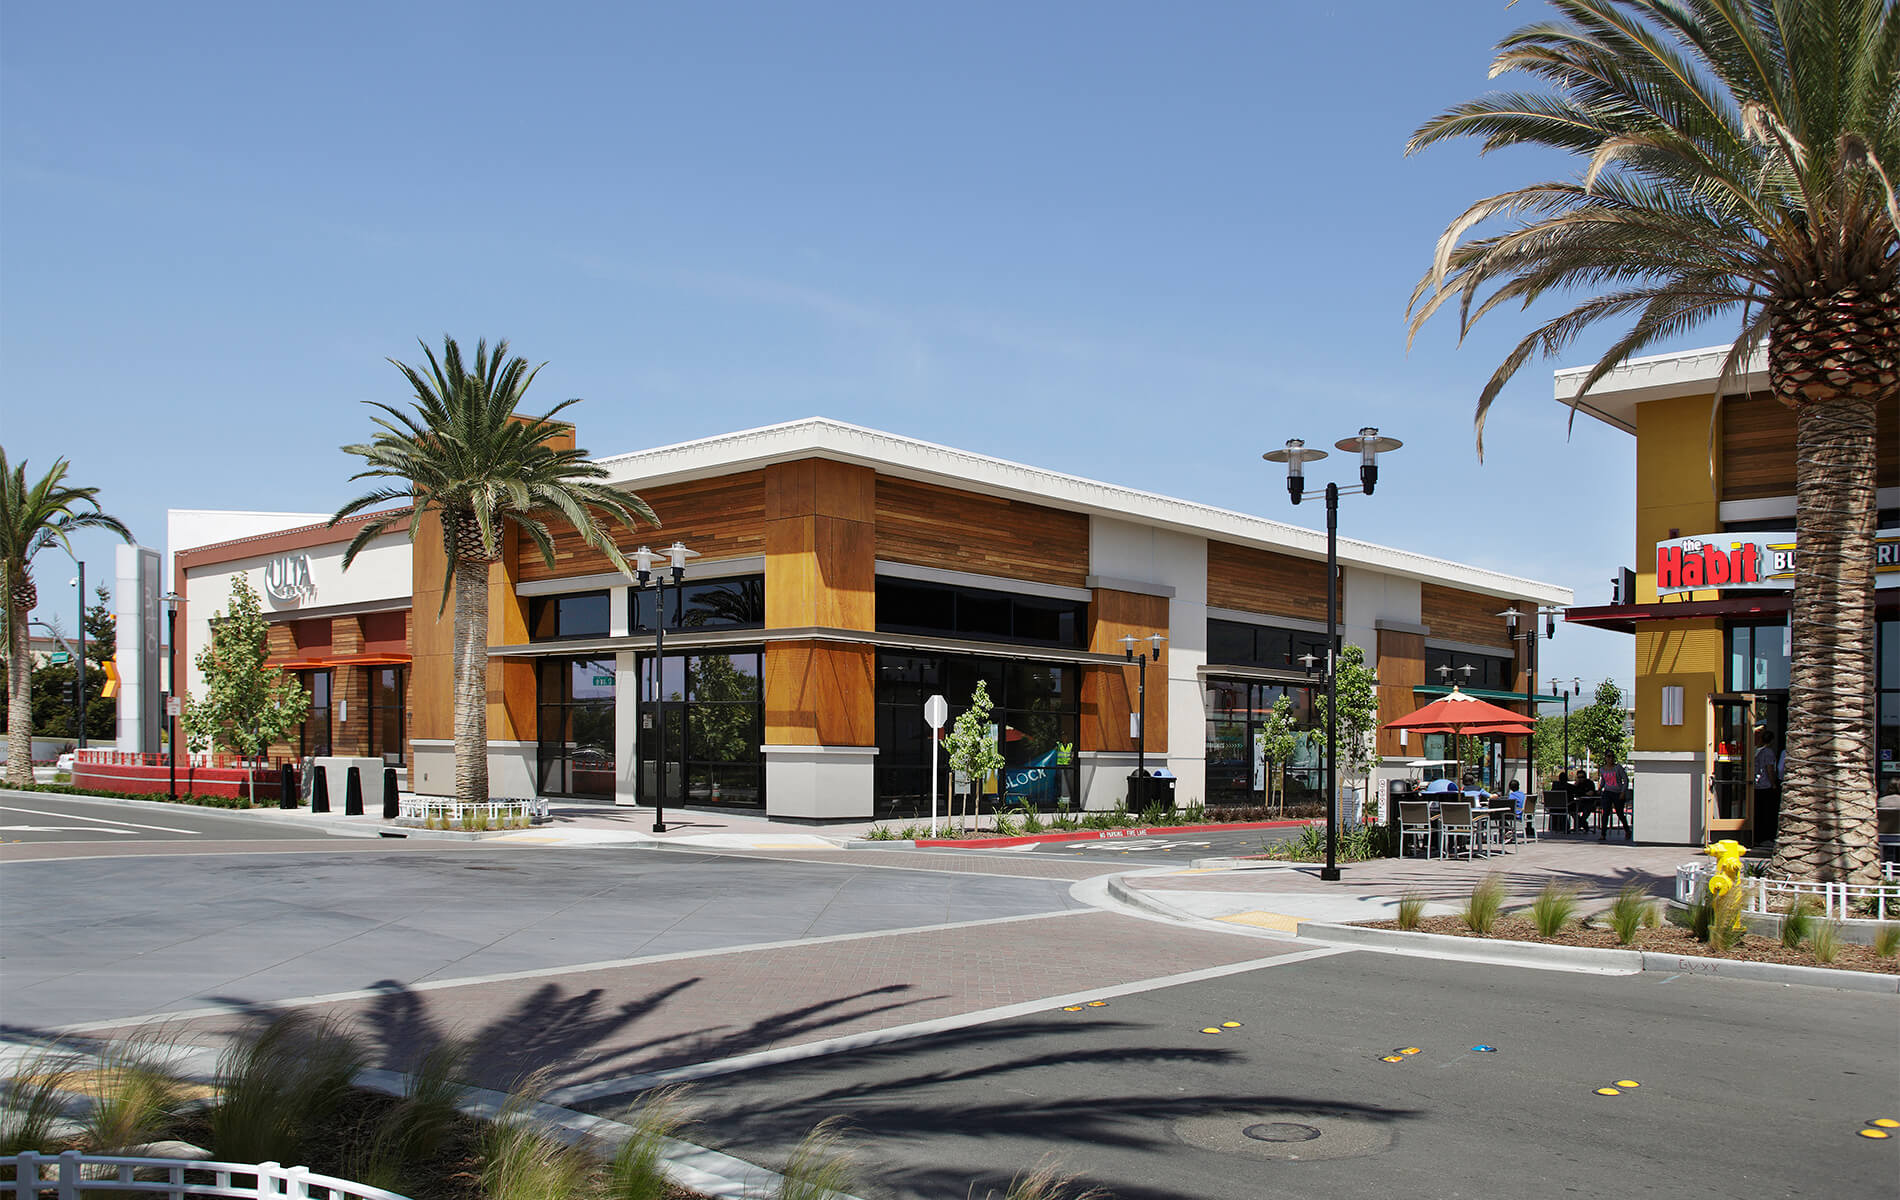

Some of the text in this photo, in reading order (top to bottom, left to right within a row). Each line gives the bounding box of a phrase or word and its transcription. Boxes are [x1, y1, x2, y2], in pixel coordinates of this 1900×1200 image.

[1682, 539, 1702, 552] the
[270, 554, 313, 590] ULTA
[1657, 541, 1758, 588] Habit
[1106, 830, 1124, 838] PARKING
[1136, 828, 1148, 836] LANE
